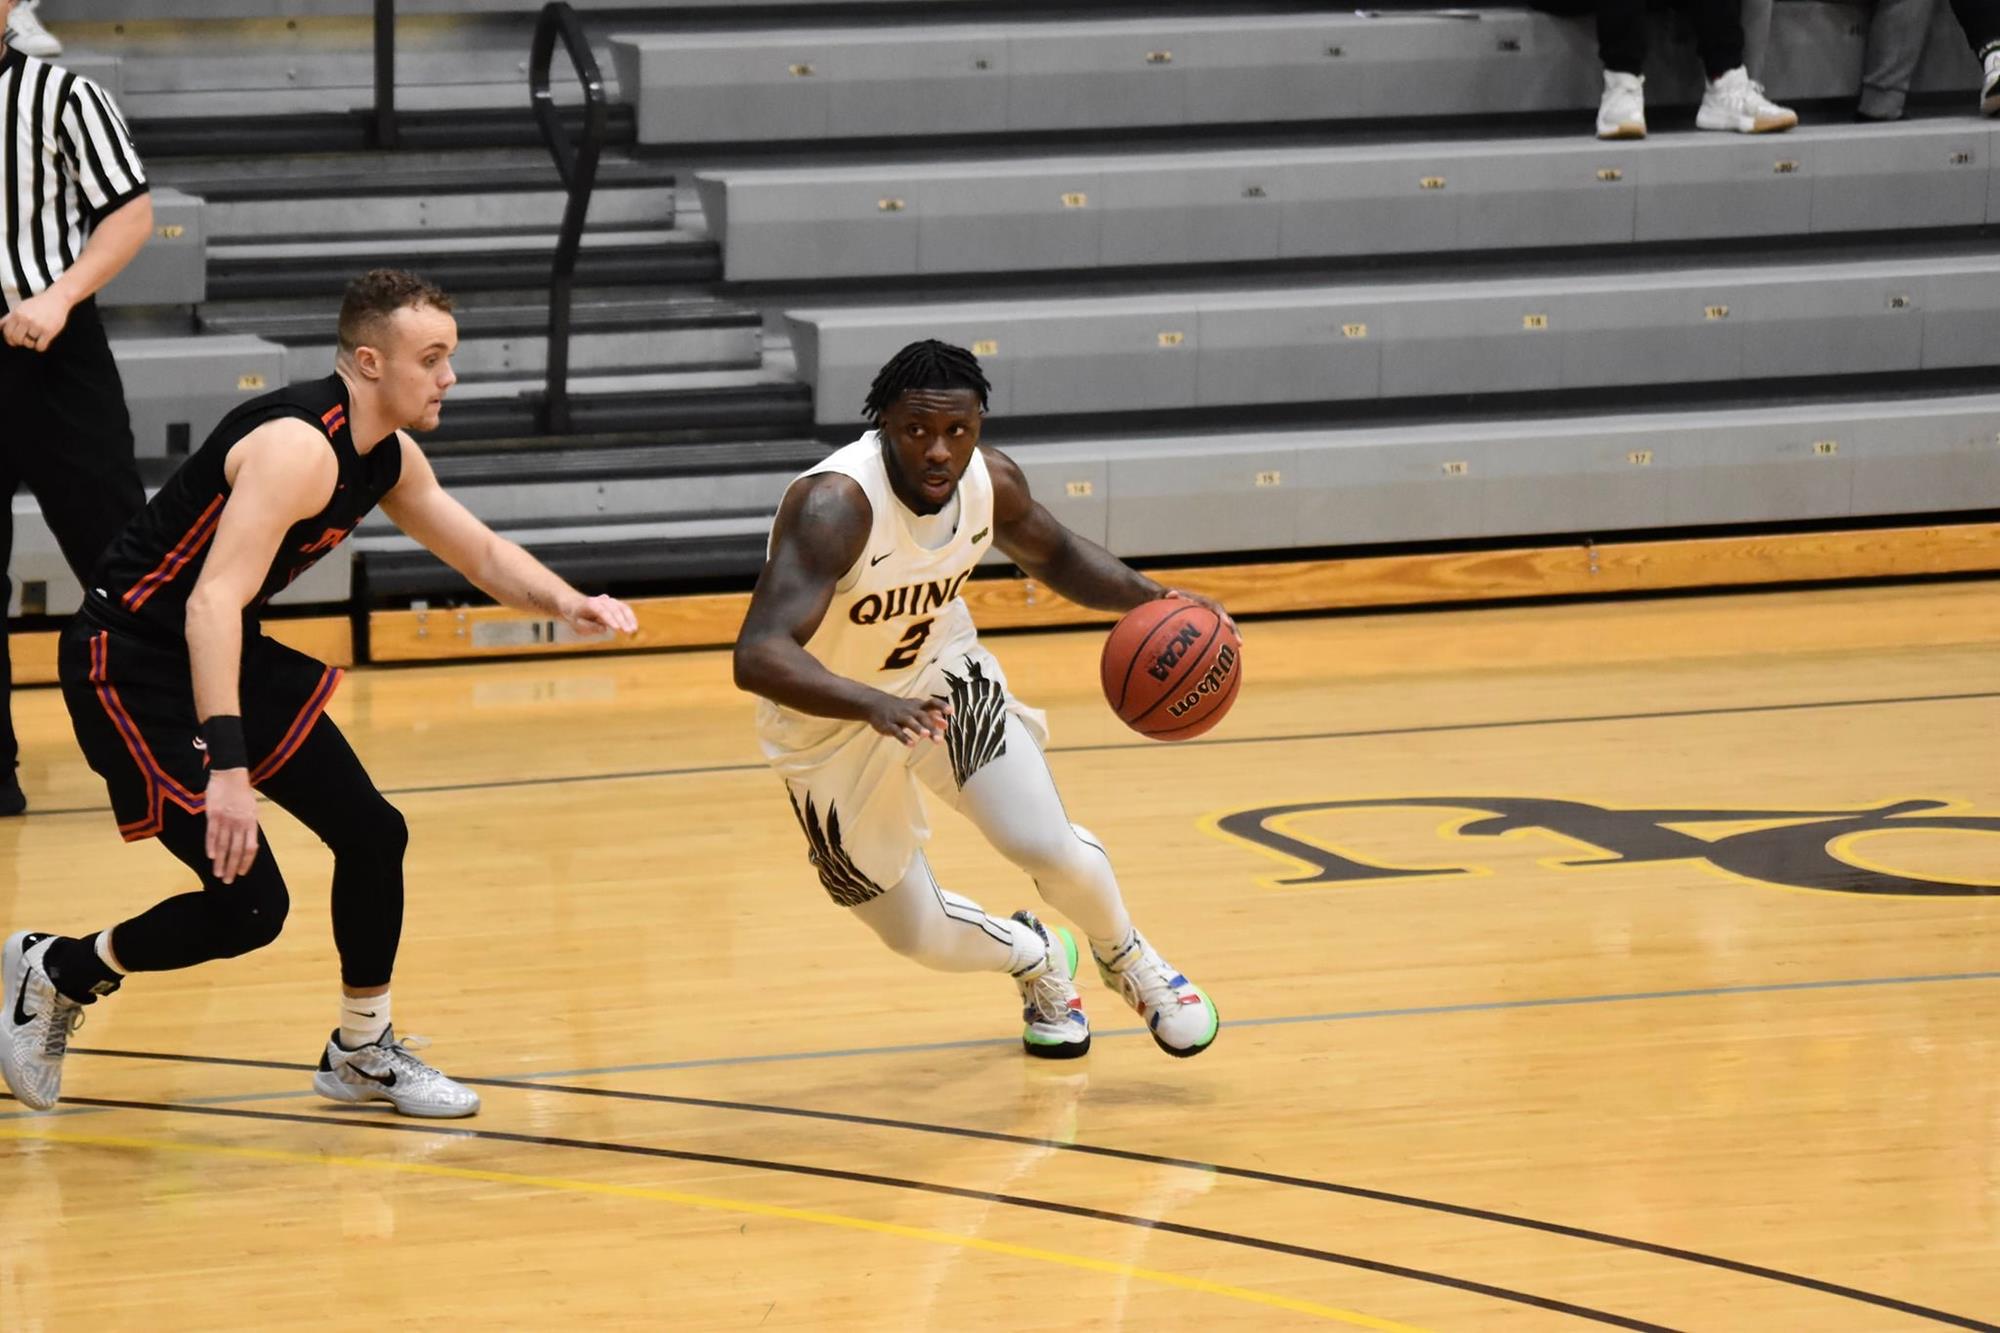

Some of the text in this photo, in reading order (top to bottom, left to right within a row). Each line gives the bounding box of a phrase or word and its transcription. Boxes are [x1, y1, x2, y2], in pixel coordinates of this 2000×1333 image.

[879, 617, 935, 671] 2
[1147, 623, 1202, 683] NCAA
[1166, 643, 1237, 718] Wilson
